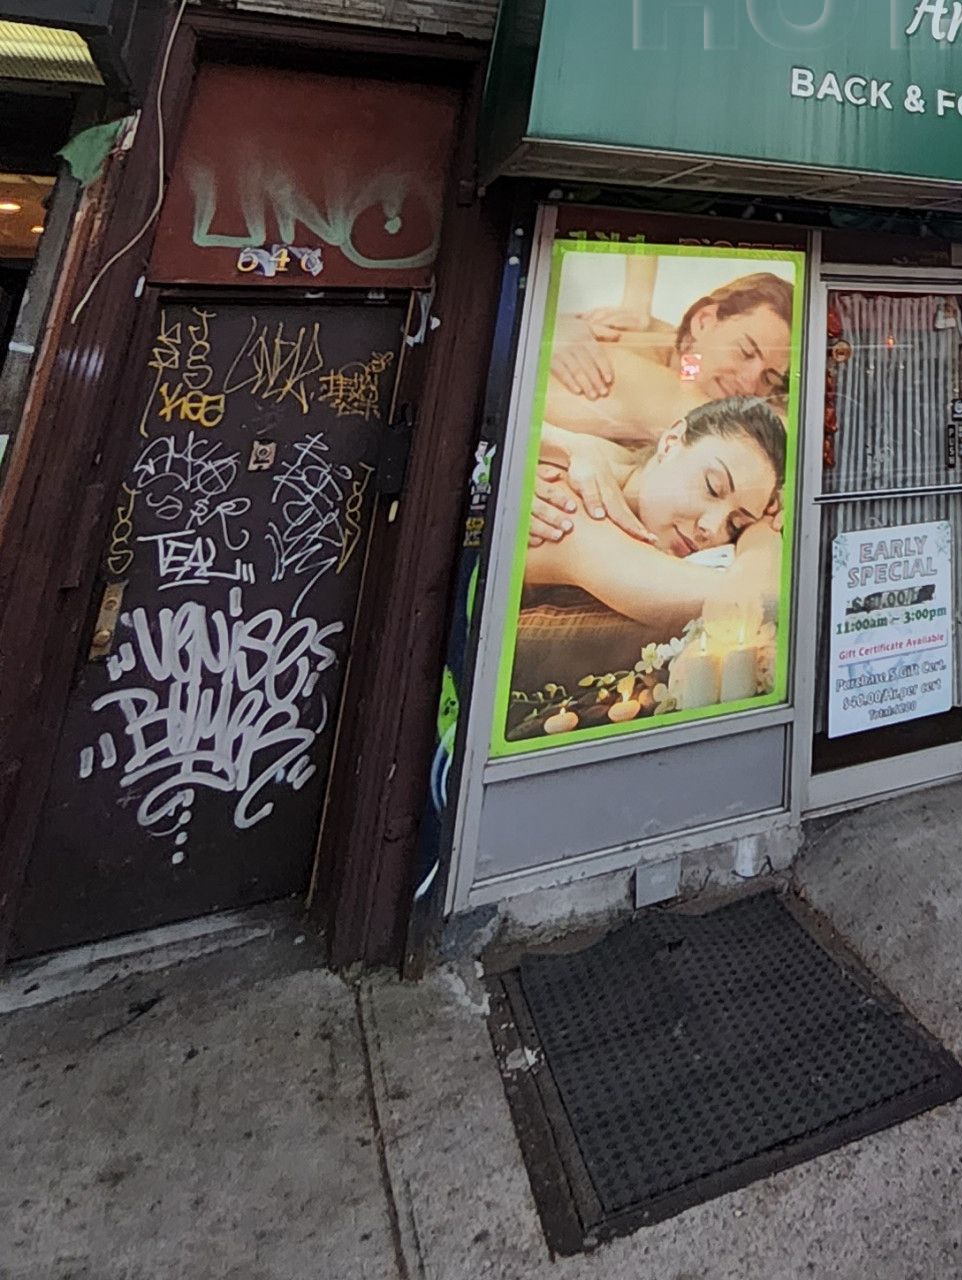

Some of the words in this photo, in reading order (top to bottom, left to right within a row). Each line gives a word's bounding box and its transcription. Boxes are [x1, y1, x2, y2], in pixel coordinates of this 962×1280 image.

[791, 67, 893, 109] BACK
[904, 85, 926, 113] &
[859, 535, 928, 563] EARLY
[847, 556, 938, 588] SPECIAL
[836, 618, 888, 635] 11:00am
[903, 607, 947, 625] 3:00pm
[838, 650, 856, 661] Gift
[858, 643, 903, 657] Certificate
[905, 634, 944, 647] Available
